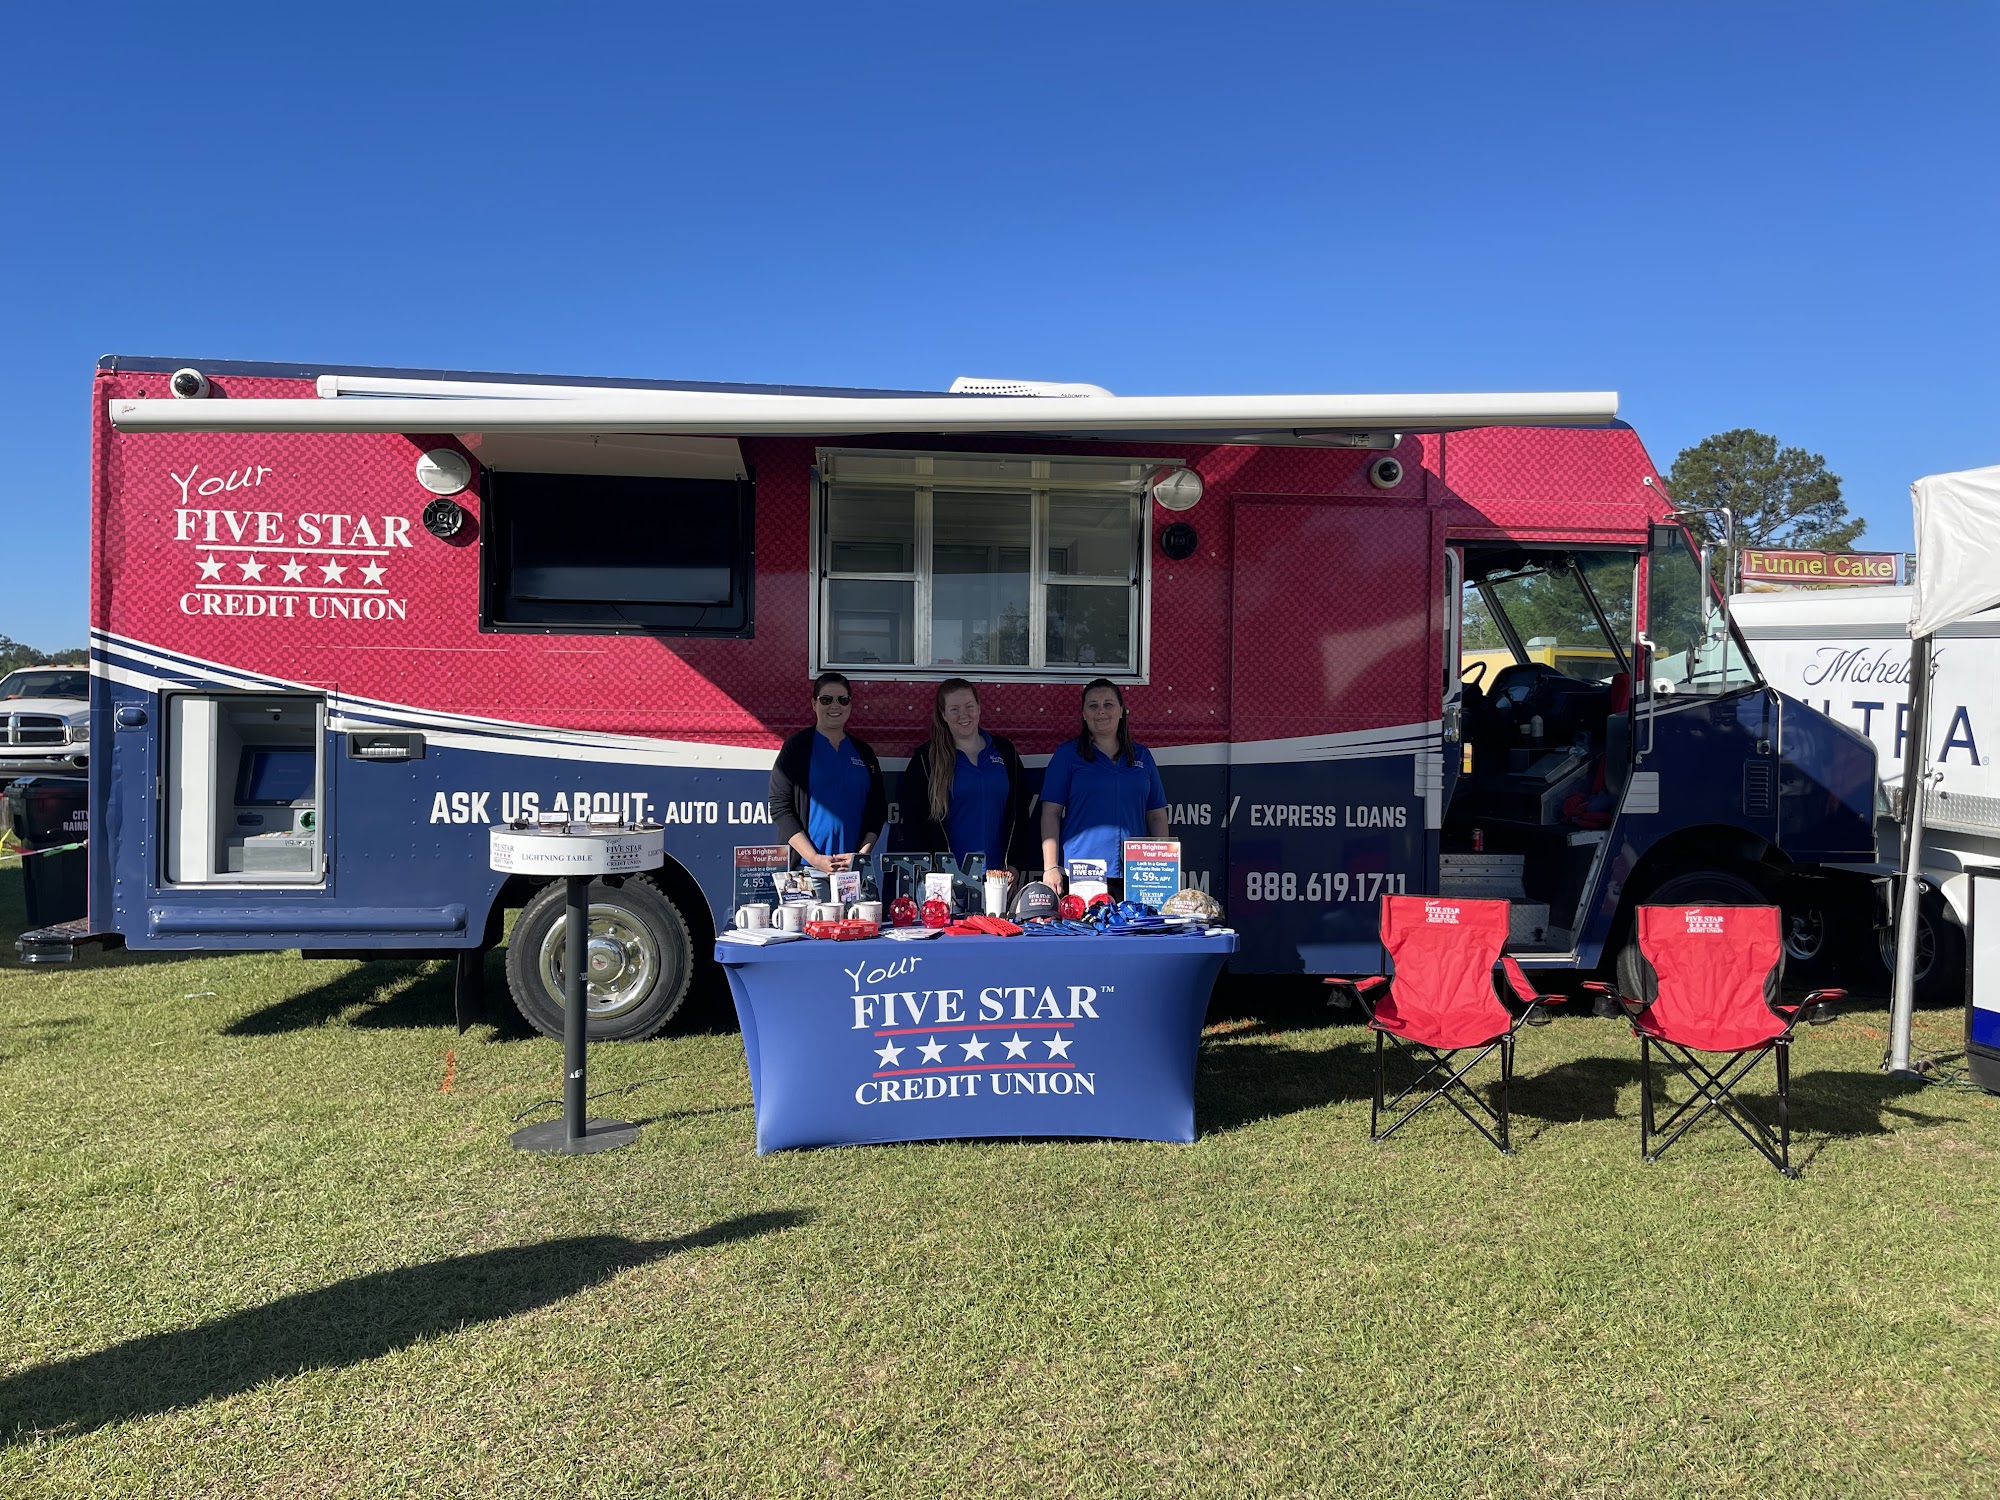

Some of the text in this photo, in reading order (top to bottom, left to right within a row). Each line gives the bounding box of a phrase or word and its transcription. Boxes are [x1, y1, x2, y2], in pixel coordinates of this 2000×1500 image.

[170, 464, 272, 504] Your
[174, 508, 414, 548] FIVE STAR
[1750, 553, 1893, 577] Funnel Cake
[179, 592, 408, 620] CREDIT UNION
[430, 792, 773, 824] ASK US ABOUT: AUTO LOA
[1166, 804, 1212, 826] ANS
[1250, 804, 1336, 828] EXPRESS
[1346, 805, 1407, 828] LOANS
[62, 821, 88, 832] RAINB
[521, 853, 565, 862] LIGHTNING
[606, 844, 642, 853] FIVE STAR
[737, 848, 778, 856] Let's Brighten
[1246, 872, 1407, 902] 888.619.1711
[844, 956, 922, 992] Your
[850, 989, 966, 1030] FIVE
[979, 986, 1099, 1022] STAR
[855, 1072, 1096, 1106] CREDIT UNION
